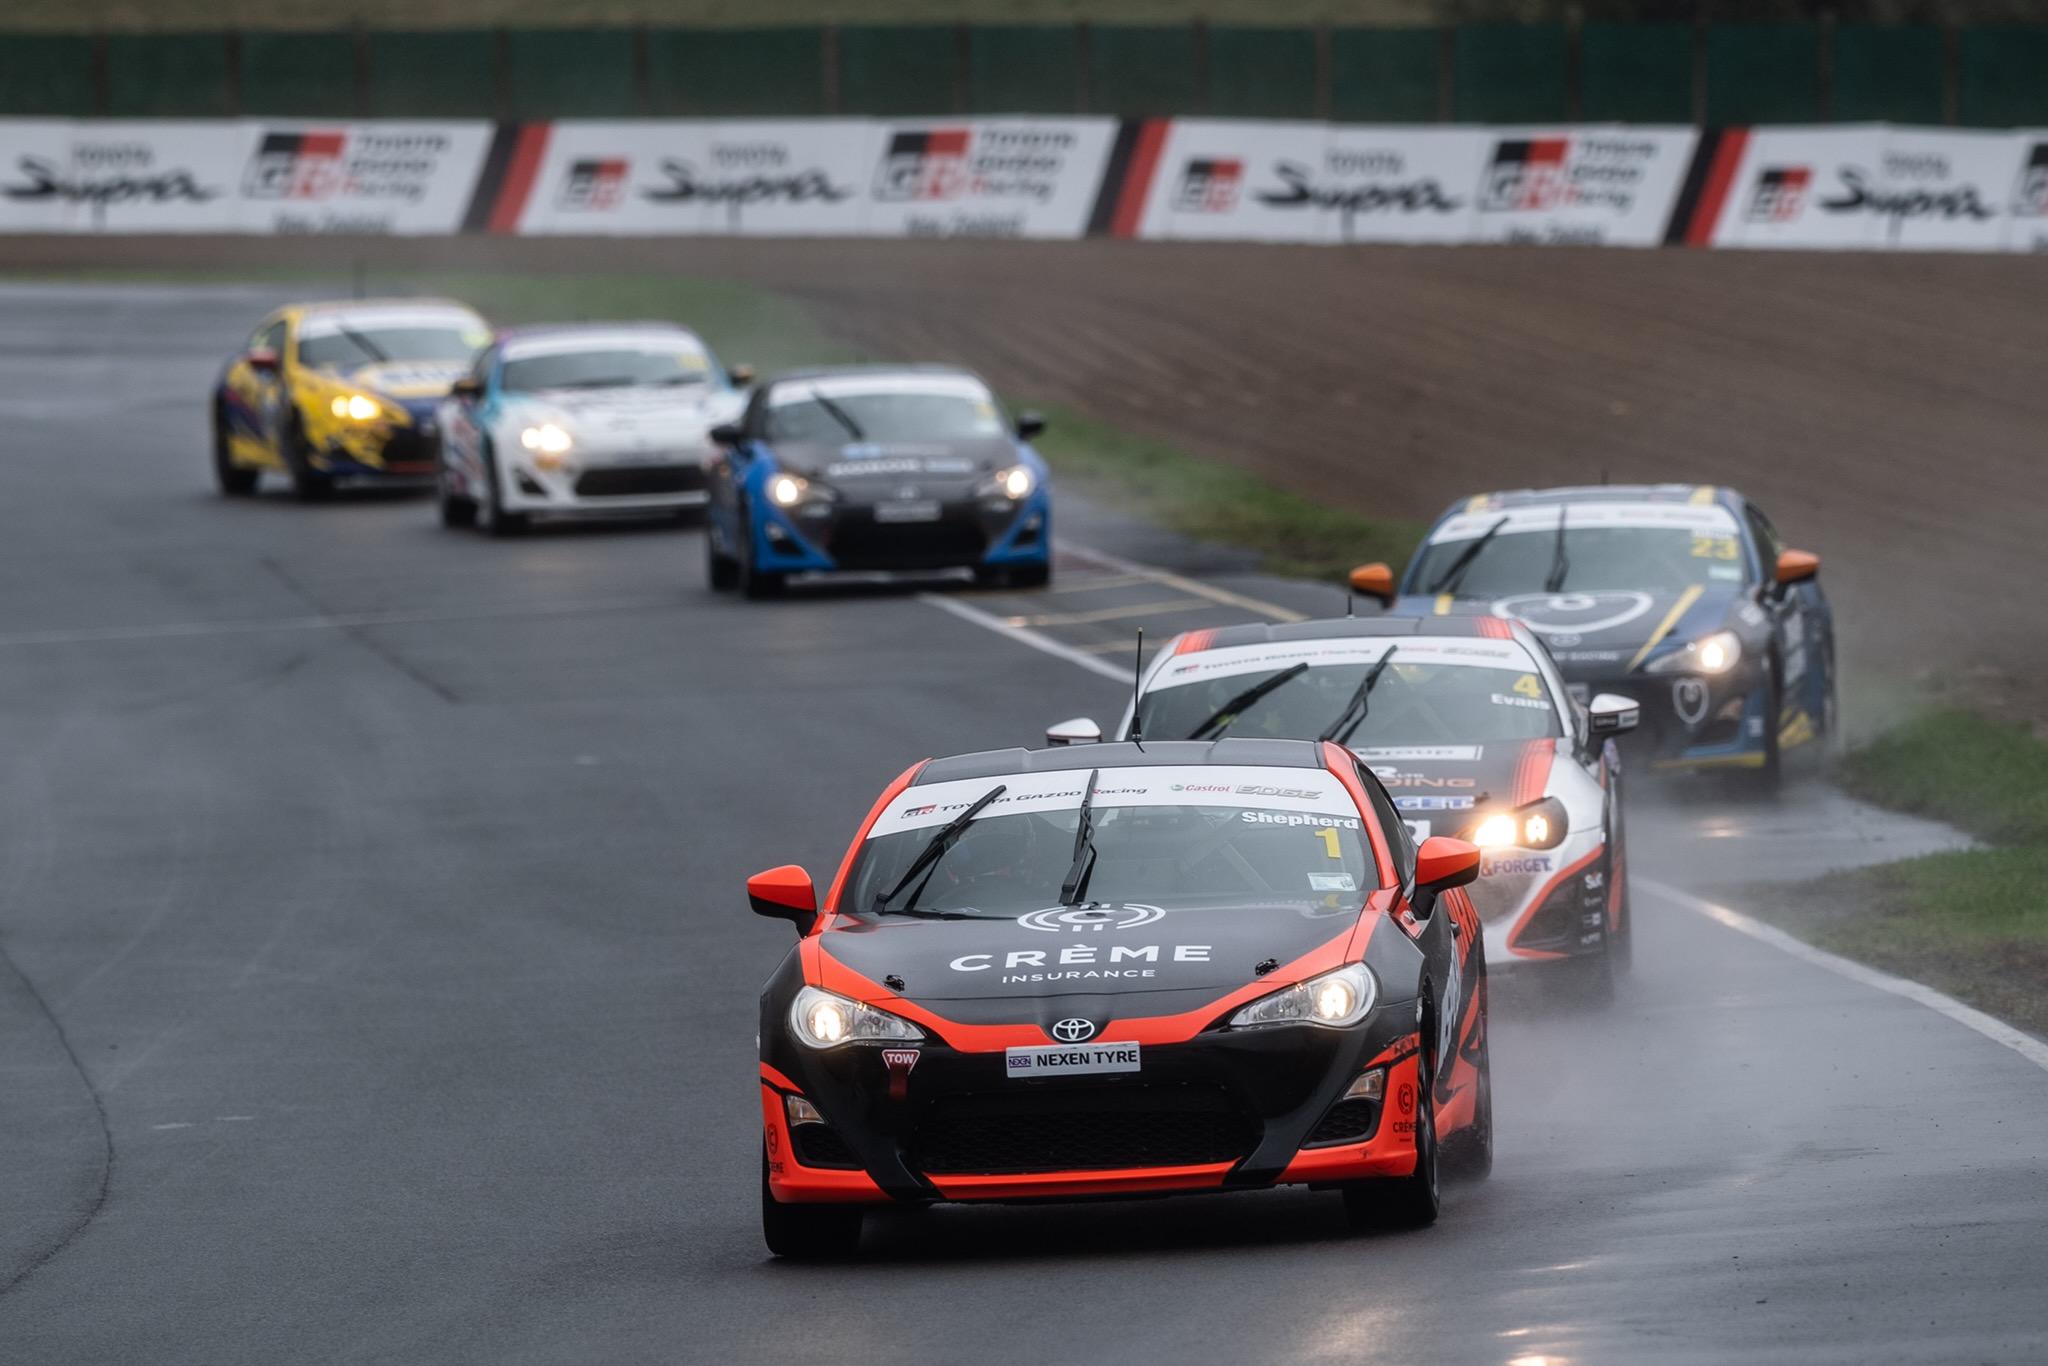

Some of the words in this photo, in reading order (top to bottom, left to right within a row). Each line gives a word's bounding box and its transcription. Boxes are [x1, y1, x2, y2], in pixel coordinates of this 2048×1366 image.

[1691, 536, 1738, 560] 23
[1513, 673, 1542, 699] 4
[1491, 692, 1550, 710] Evans
[940, 797, 1011, 812] TOYTA
[1016, 790, 1081, 801] GAZOO
[1185, 784, 1230, 793] Castrol
[1235, 784, 1324, 800] EDGE
[1241, 811, 1359, 830] Shepherd
[1314, 827, 1341, 859] 1
[950, 944, 1212, 972] CRÈME
[1001, 969, 1156, 983] INSURANCE
[887, 1054, 914, 1064] TOW
[1036, 1052, 1090, 1067] NEXEN
[1094, 1050, 1138, 1064] TYRE
